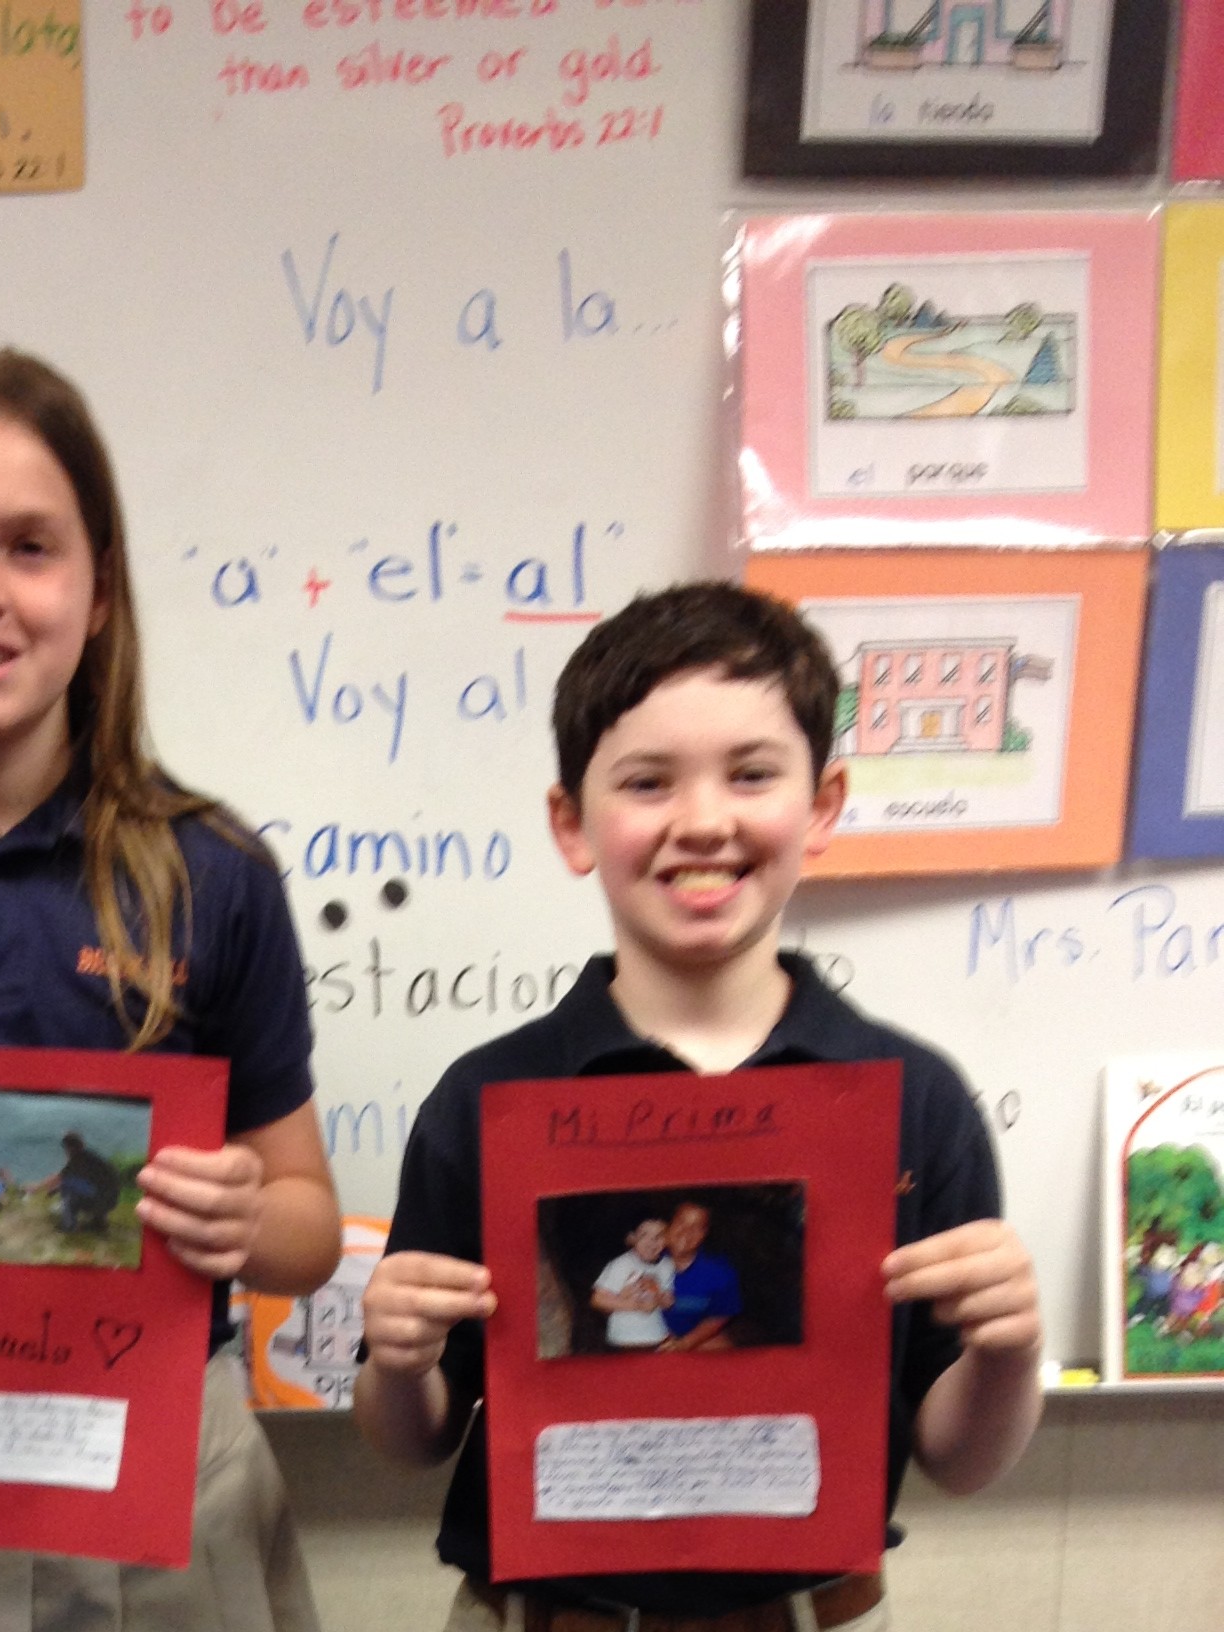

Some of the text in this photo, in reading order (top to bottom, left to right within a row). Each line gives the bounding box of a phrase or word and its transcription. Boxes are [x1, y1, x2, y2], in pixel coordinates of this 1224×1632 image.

[477, 46, 528, 83] or
[558, 34, 663, 107] gold
[281, 231, 396, 396] Voy
[456, 288, 504, 353] a
[288, 631, 528, 765] Voy al
